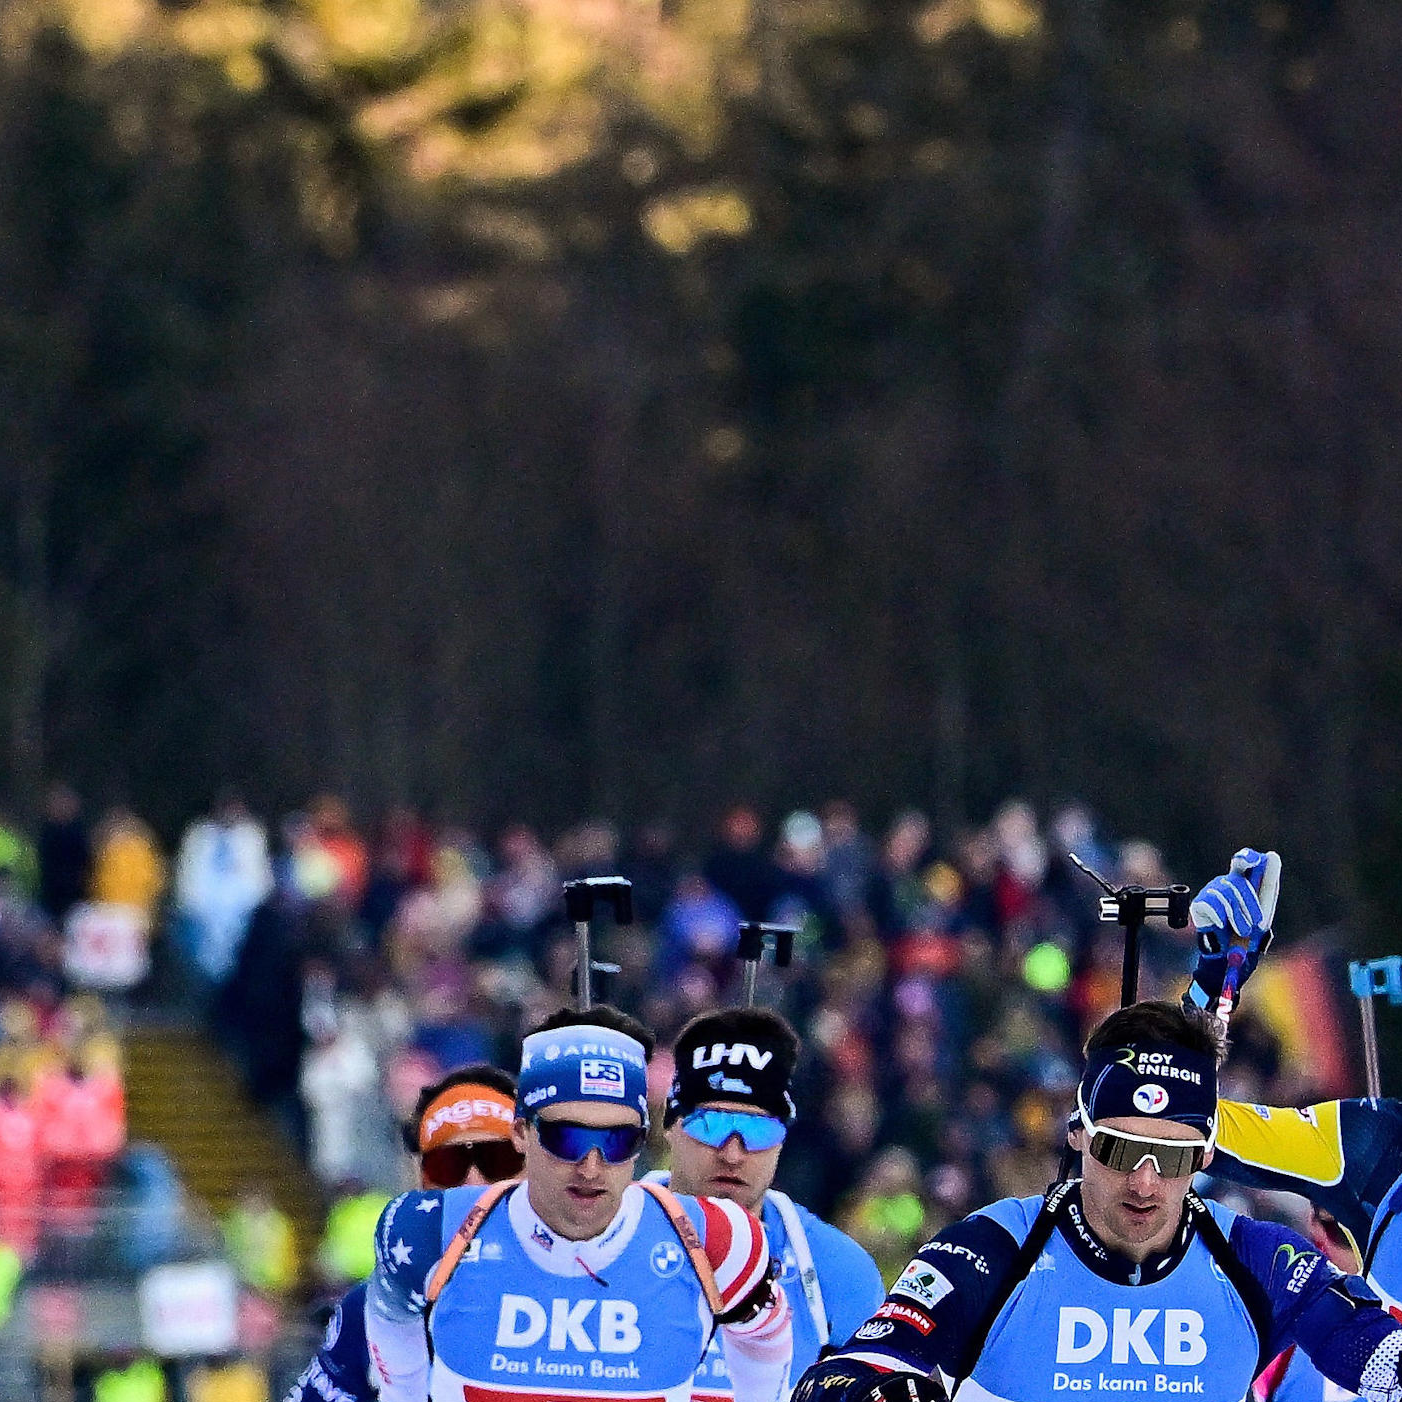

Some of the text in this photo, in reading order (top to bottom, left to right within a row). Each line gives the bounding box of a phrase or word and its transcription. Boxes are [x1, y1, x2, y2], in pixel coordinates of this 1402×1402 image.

[692, 1043, 773, 1071] LHV
[1139, 1053, 1173, 1065] ROY
[1137, 1064, 1202, 1086] ENERGIE
[1068, 1204, 1098, 1249] CRAFT
[918, 1242, 976, 1260] CRAFT
[1286, 1257, 1308, 1291] ROY
[495, 1294, 642, 1354] DKB
[1056, 1307, 1207, 1366] DKB
[492, 1353, 640, 1380] Das kann Bank
[1053, 1373, 1204, 1395] Das kann Bank
